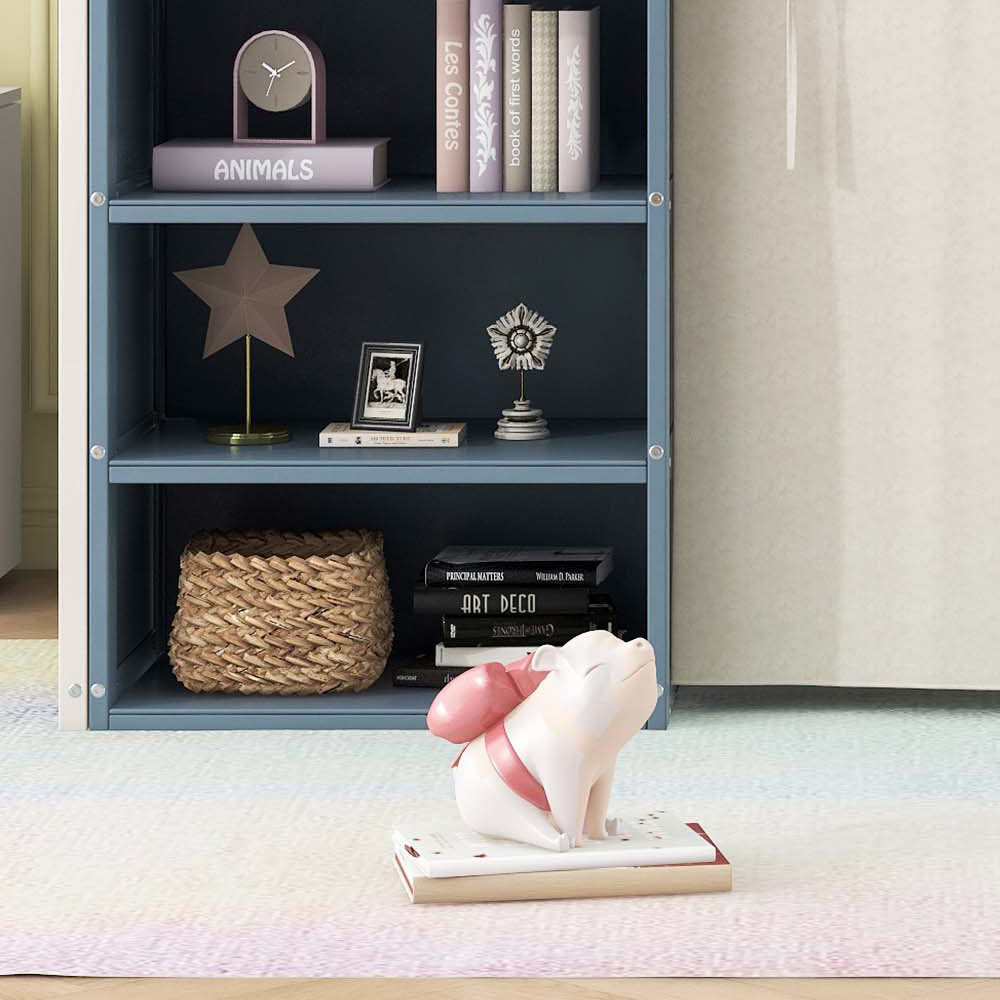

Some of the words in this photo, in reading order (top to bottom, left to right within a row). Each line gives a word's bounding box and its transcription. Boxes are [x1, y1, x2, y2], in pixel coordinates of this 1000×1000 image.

[444, 41, 463, 75] Les
[508, 28, 521, 74] words
[508, 78, 521, 105] first
[444, 82, 463, 150] Contes
[508, 108, 521, 124] of
[508, 129, 521, 166] book
[214, 159, 314, 181] ANIMALS
[446, 571, 477, 581] PRINCIPAL
[477, 571, 504, 581] MATTERS
[461, 594, 490, 614] ART
[500, 594, 536, 614] DECO
